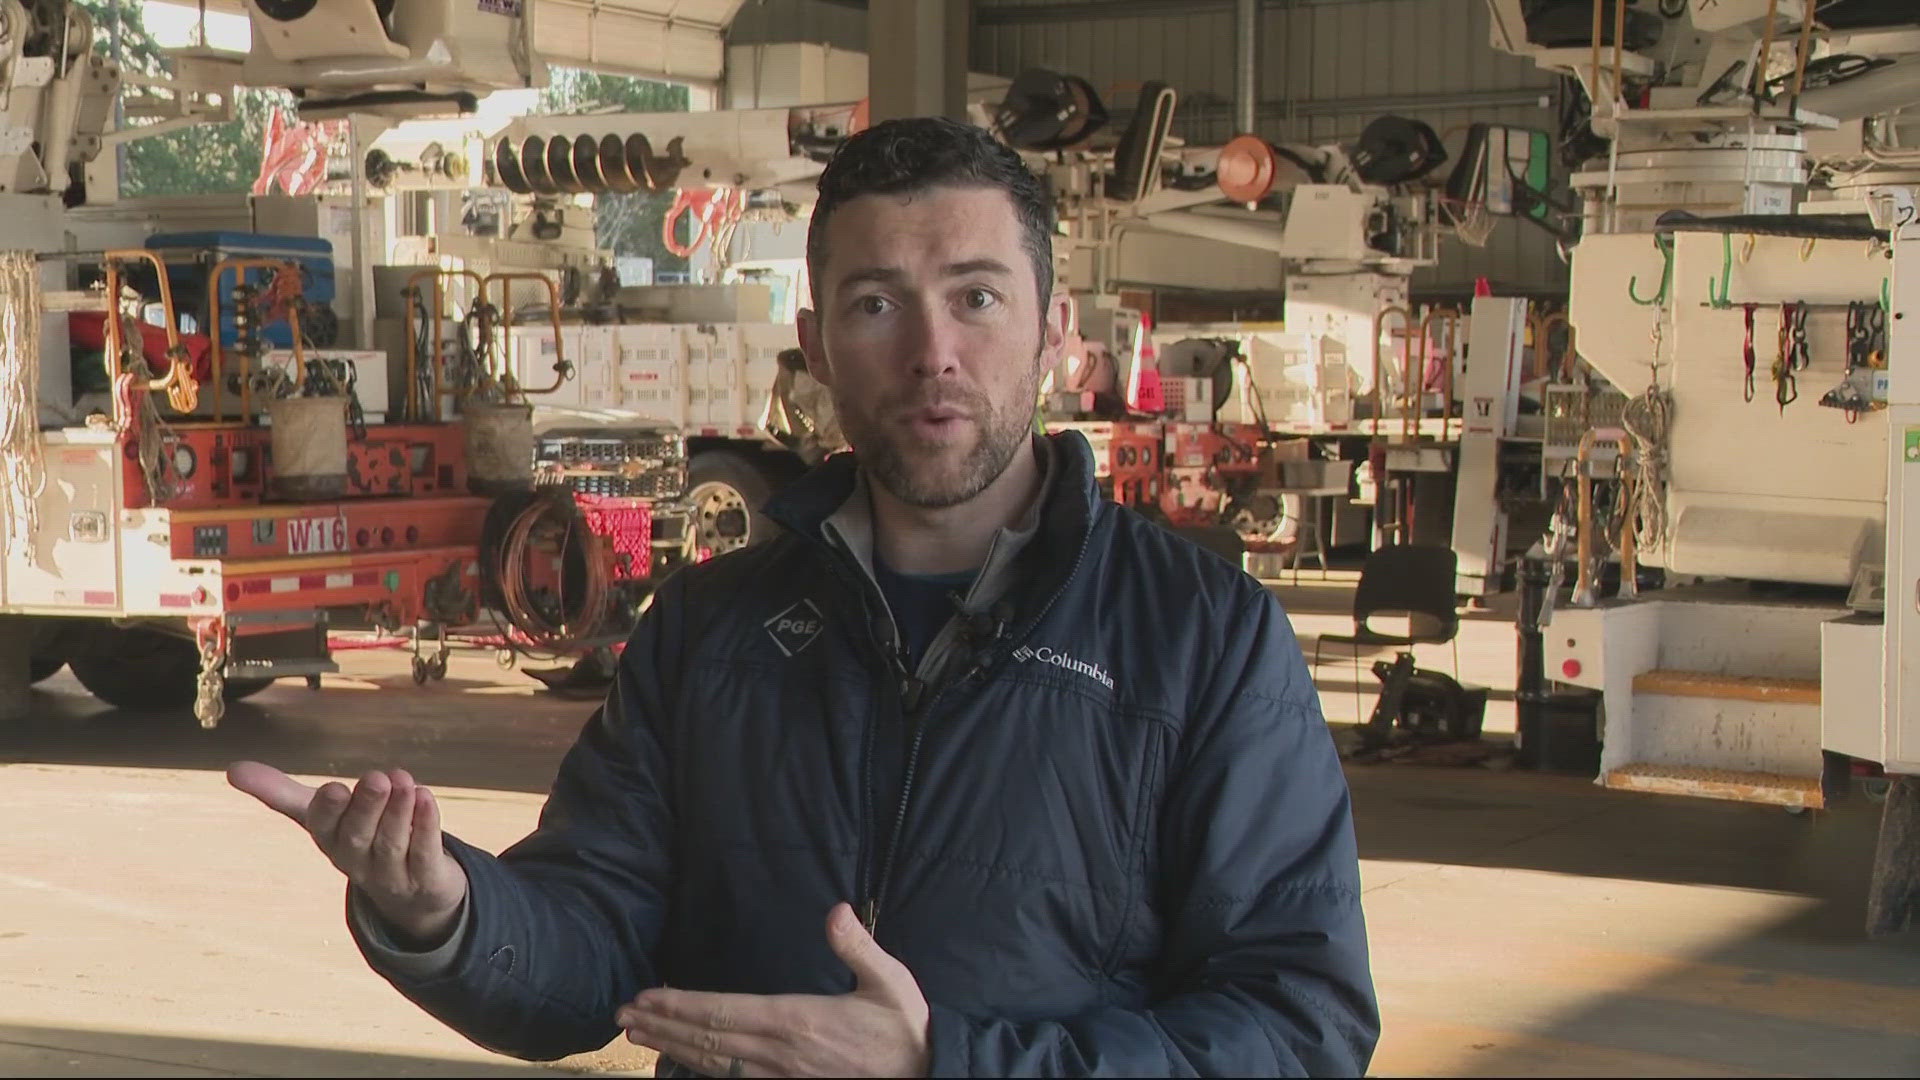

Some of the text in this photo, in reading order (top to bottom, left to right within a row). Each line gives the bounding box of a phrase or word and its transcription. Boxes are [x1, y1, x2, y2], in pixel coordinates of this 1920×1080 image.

[289, 518, 345, 552] W16
[776, 619, 818, 634] PGE
[1036, 646, 1115, 690] Columbia
